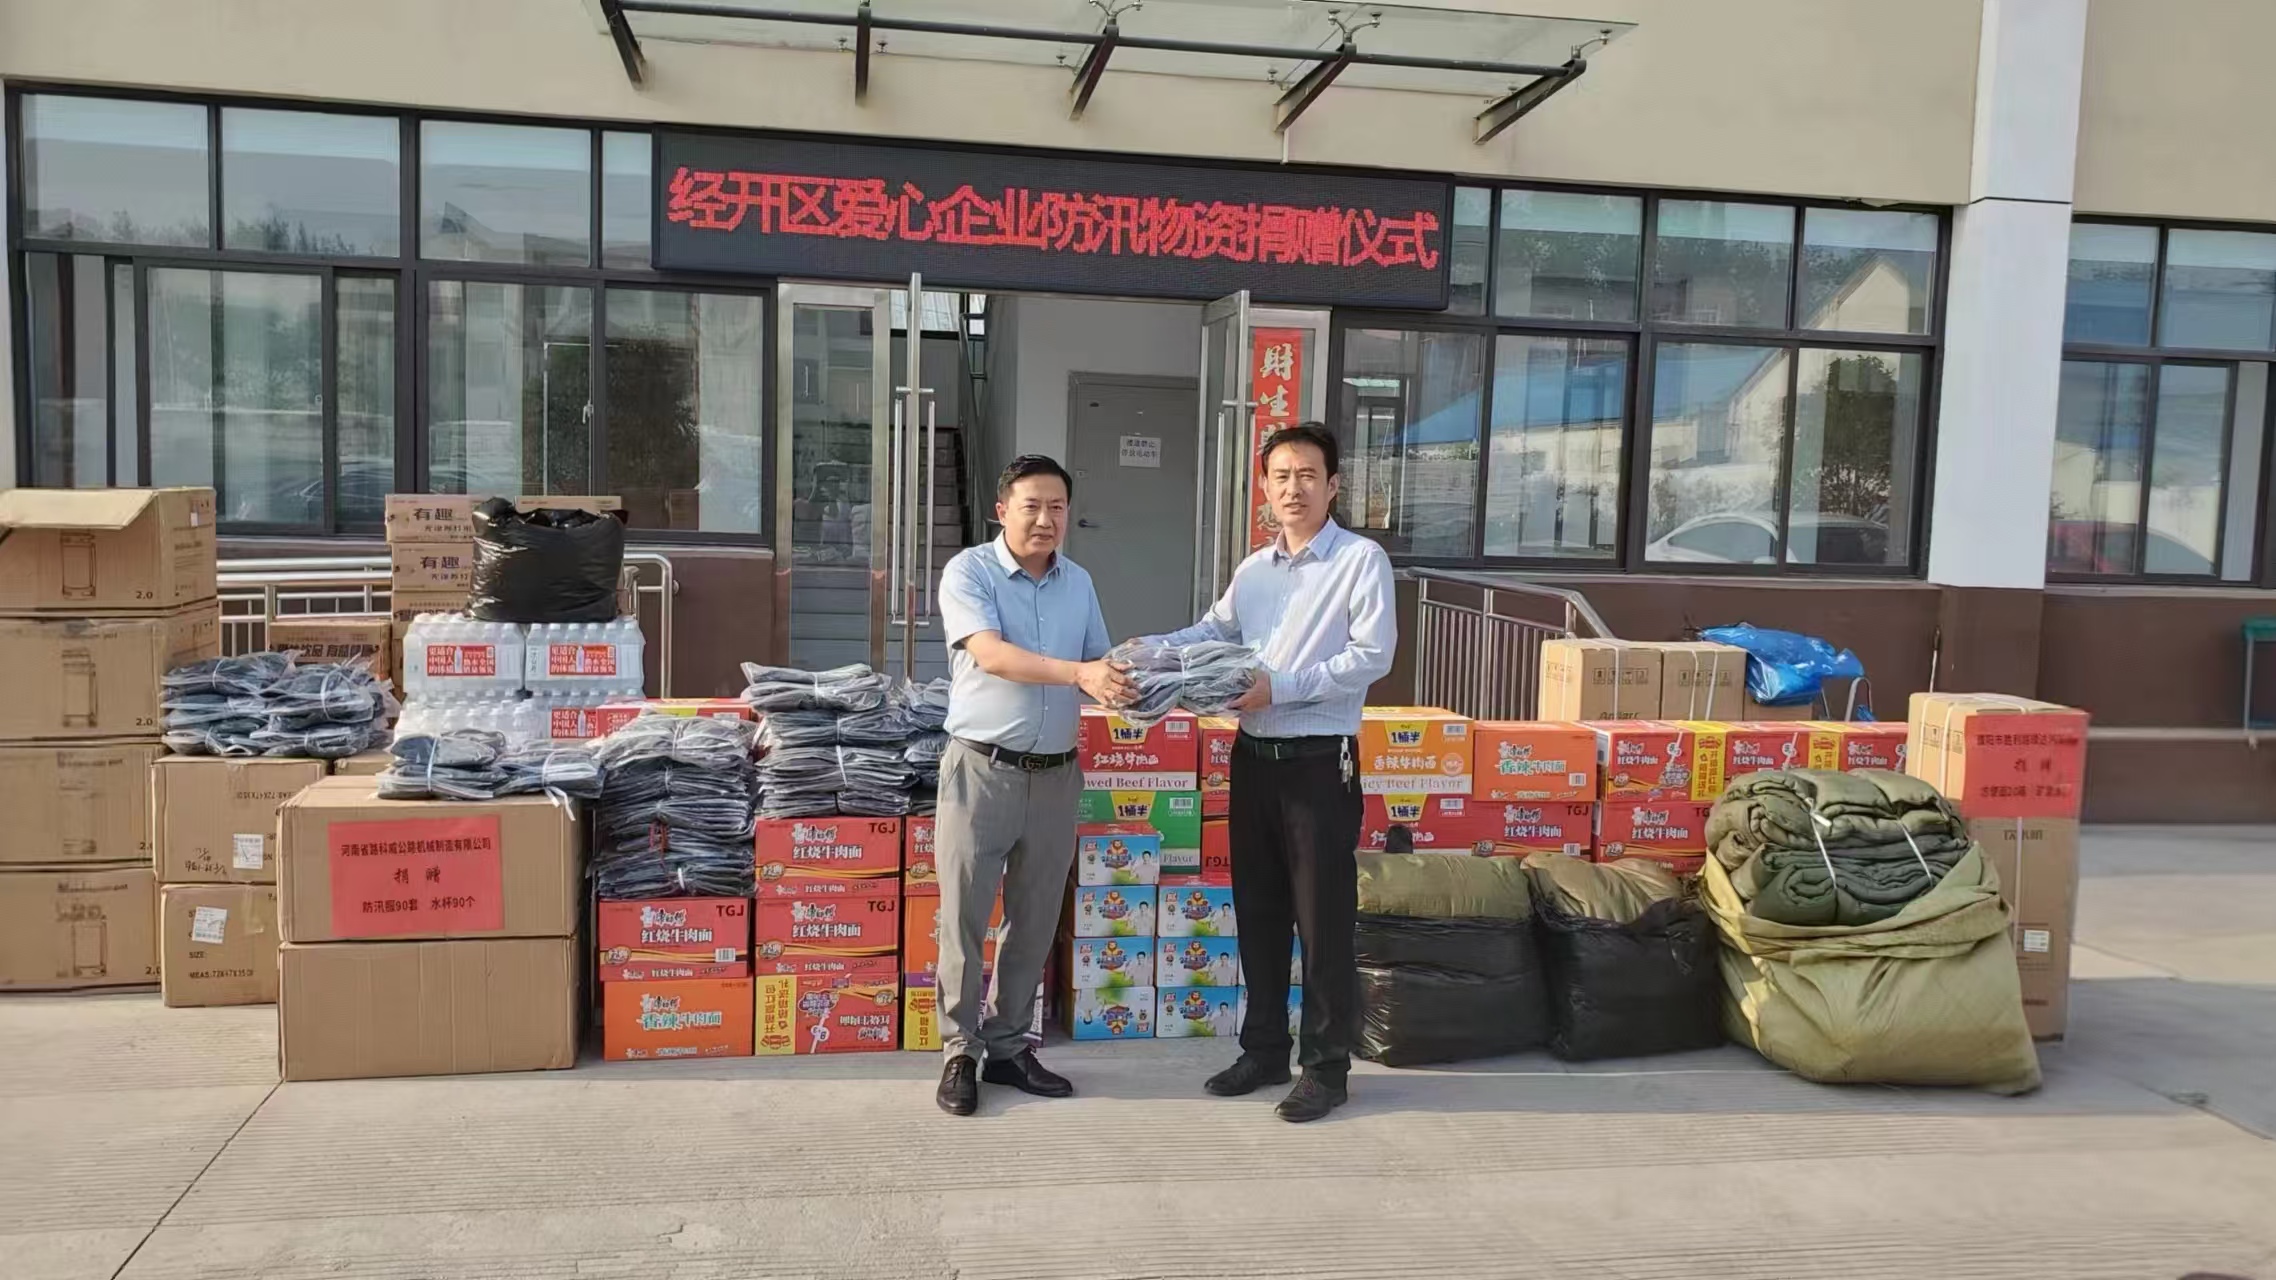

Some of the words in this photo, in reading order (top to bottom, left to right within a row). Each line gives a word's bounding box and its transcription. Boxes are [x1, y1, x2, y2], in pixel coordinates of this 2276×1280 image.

[667, 165, 1440, 269] 经开区爱心企业防汛物资捐赠仪式
[135, 591, 153, 599] 2.0
[135, 718, 153, 726] 2.0
[1112, 727, 1143, 740] 1桶半
[1390, 731, 1420, 743] 1桶半
[1093, 752, 1159, 769] 红烧牛肉面
[1374, 755, 1437, 771] 香辣牛肉面
[1086, 777, 1112, 788] wed
[1116, 777, 1146, 788] Beef
[1148, 777, 1189, 788] Flavor
[1363, 778, 1383, 791] icy
[1420, 777, 1464, 789] Flavor
[1117, 804, 1148, 817] 1桶半
[1390, 805, 1421, 818] 1桶半
[1566, 805, 1589, 816] TGJ
[1695, 807, 1710, 817] TG
[869, 822, 896, 834] TGJ
[1504, 825, 1562, 838] 红烧牛肉面
[1632, 827, 1689, 839] 红烧牛肉面
[793, 845, 862, 859] 红烧牛肉面
[1163, 854, 1193, 863] Flavor
[393, 867, 409, 884] 捐
[425, 865, 441, 884] 赠
[431, 895, 475, 911] 水杯90个
[867, 900, 895, 912] TGJ
[716, 904, 745, 917] TGJ
[641, 928, 713, 943] 红烧牛肉面
[792, 923, 861, 938] 红烧牛肉面
[641, 1012, 722, 1030] 香辣牛肉面
[839, 1014, 890, 1025] 红烧牛肉面
